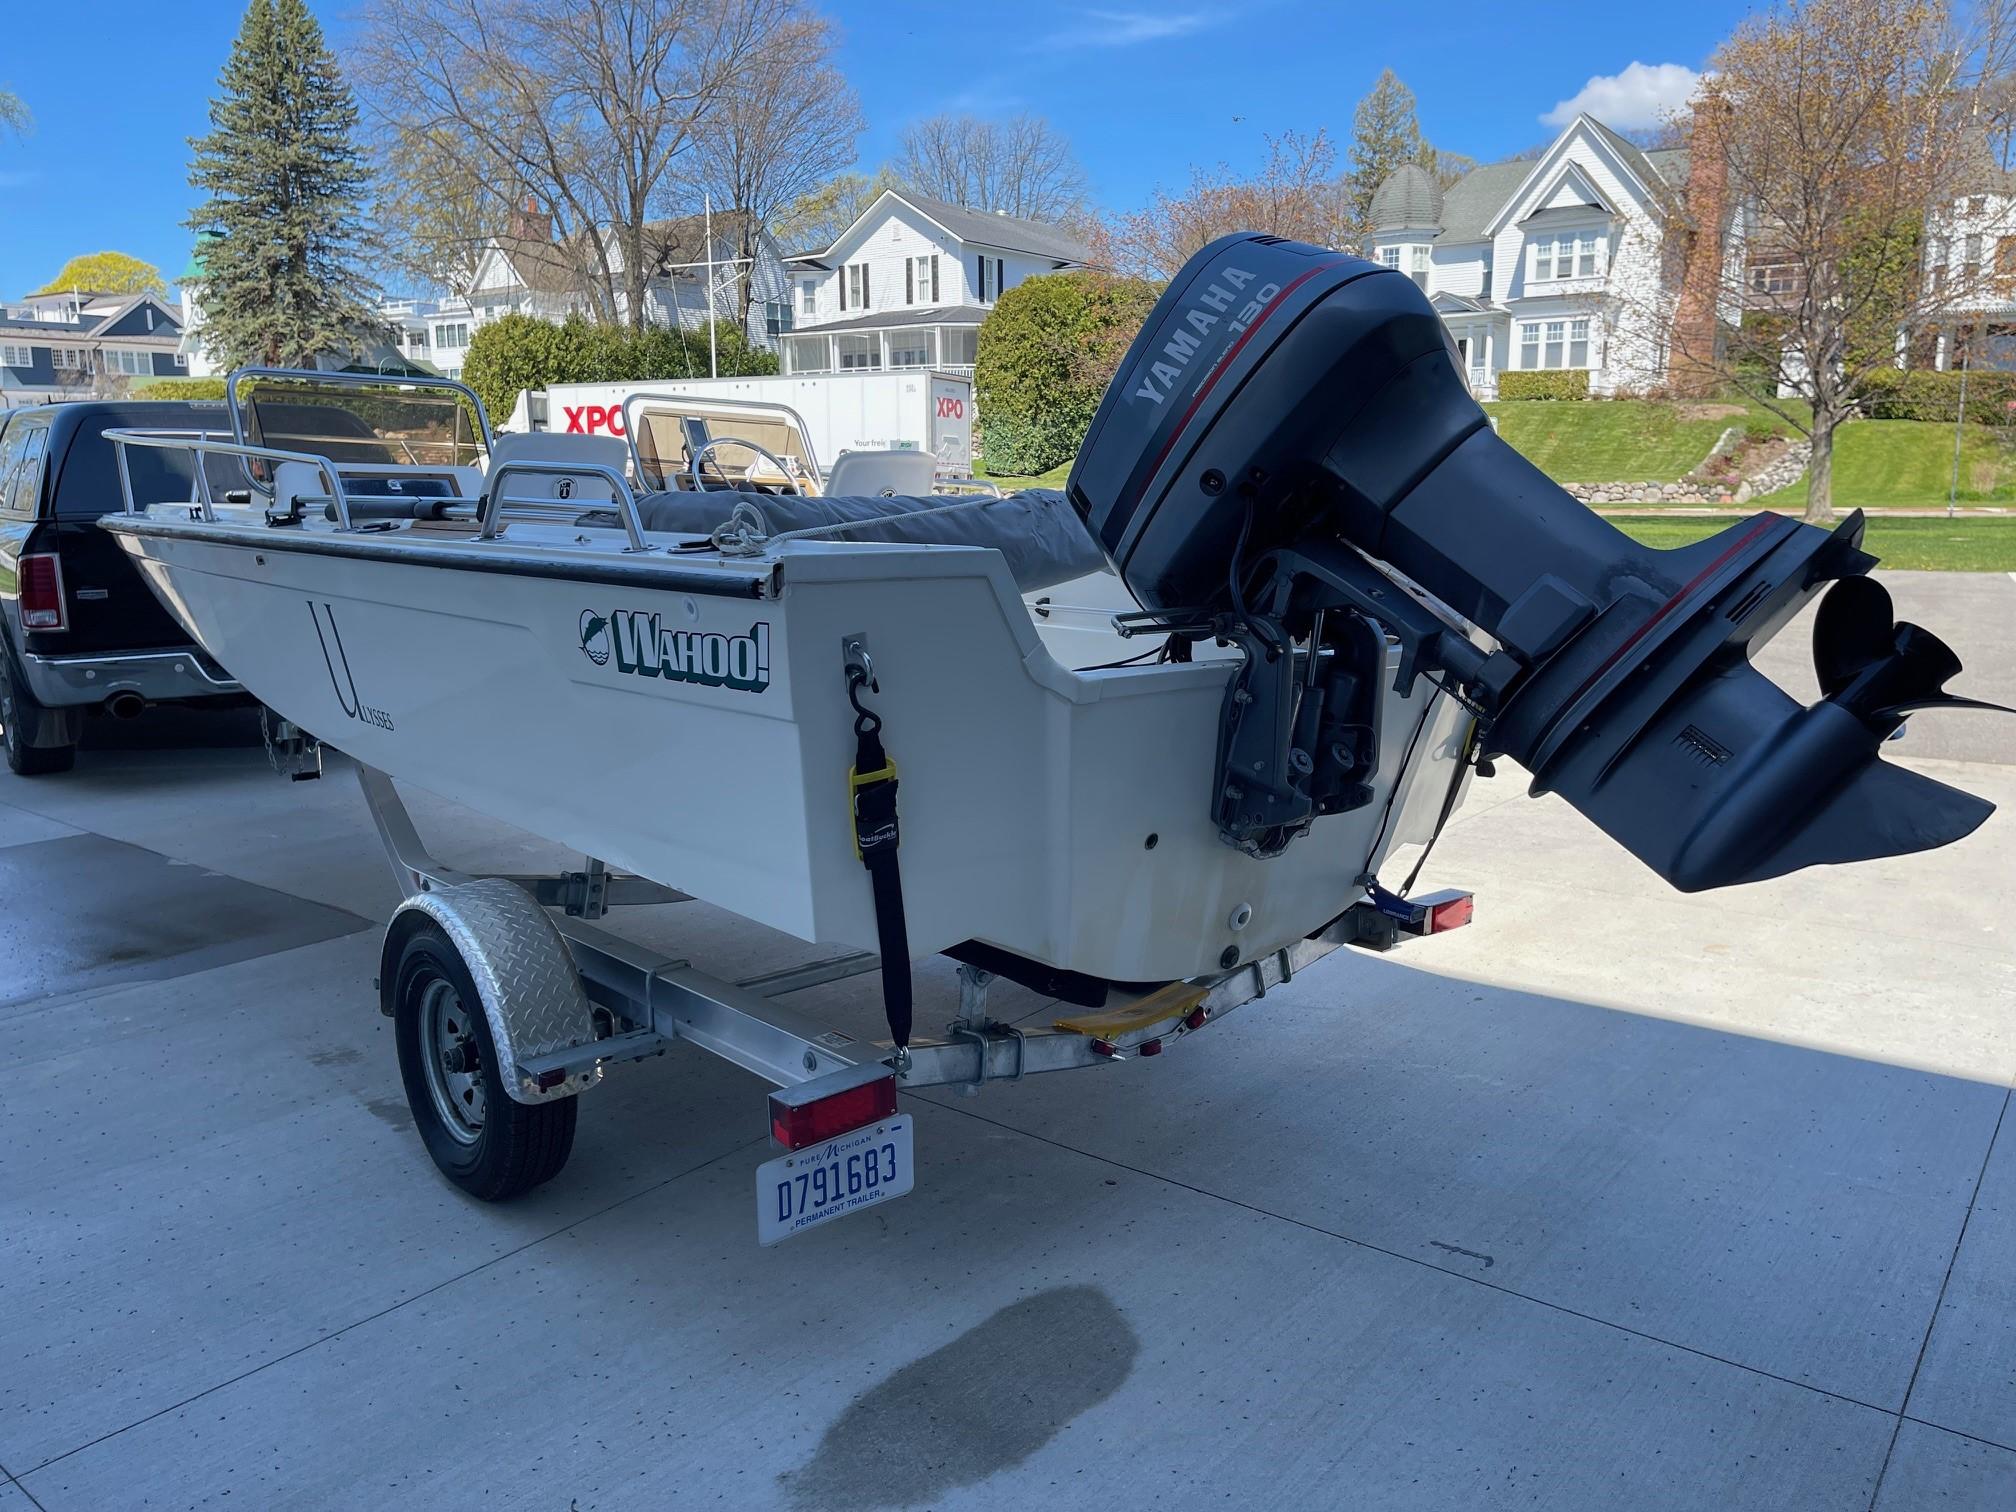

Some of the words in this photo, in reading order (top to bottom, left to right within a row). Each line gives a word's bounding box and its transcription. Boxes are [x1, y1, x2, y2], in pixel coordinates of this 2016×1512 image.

[1228, 283, 1281, 333] 130
[1135, 266, 1257, 405] YAMAHA
[937, 397, 963, 419] XPO
[854, 439, 869, 447] Your
[306, 601, 395, 732] ULYSSES
[800, 1153, 821, 1167] PURE
[817, 1135, 872, 1166] MICHIGAN
[777, 1142, 897, 1222] D791683
[795, 1202, 845, 1228] PERMANENT
[846, 1189, 880, 1208] TRAILER
